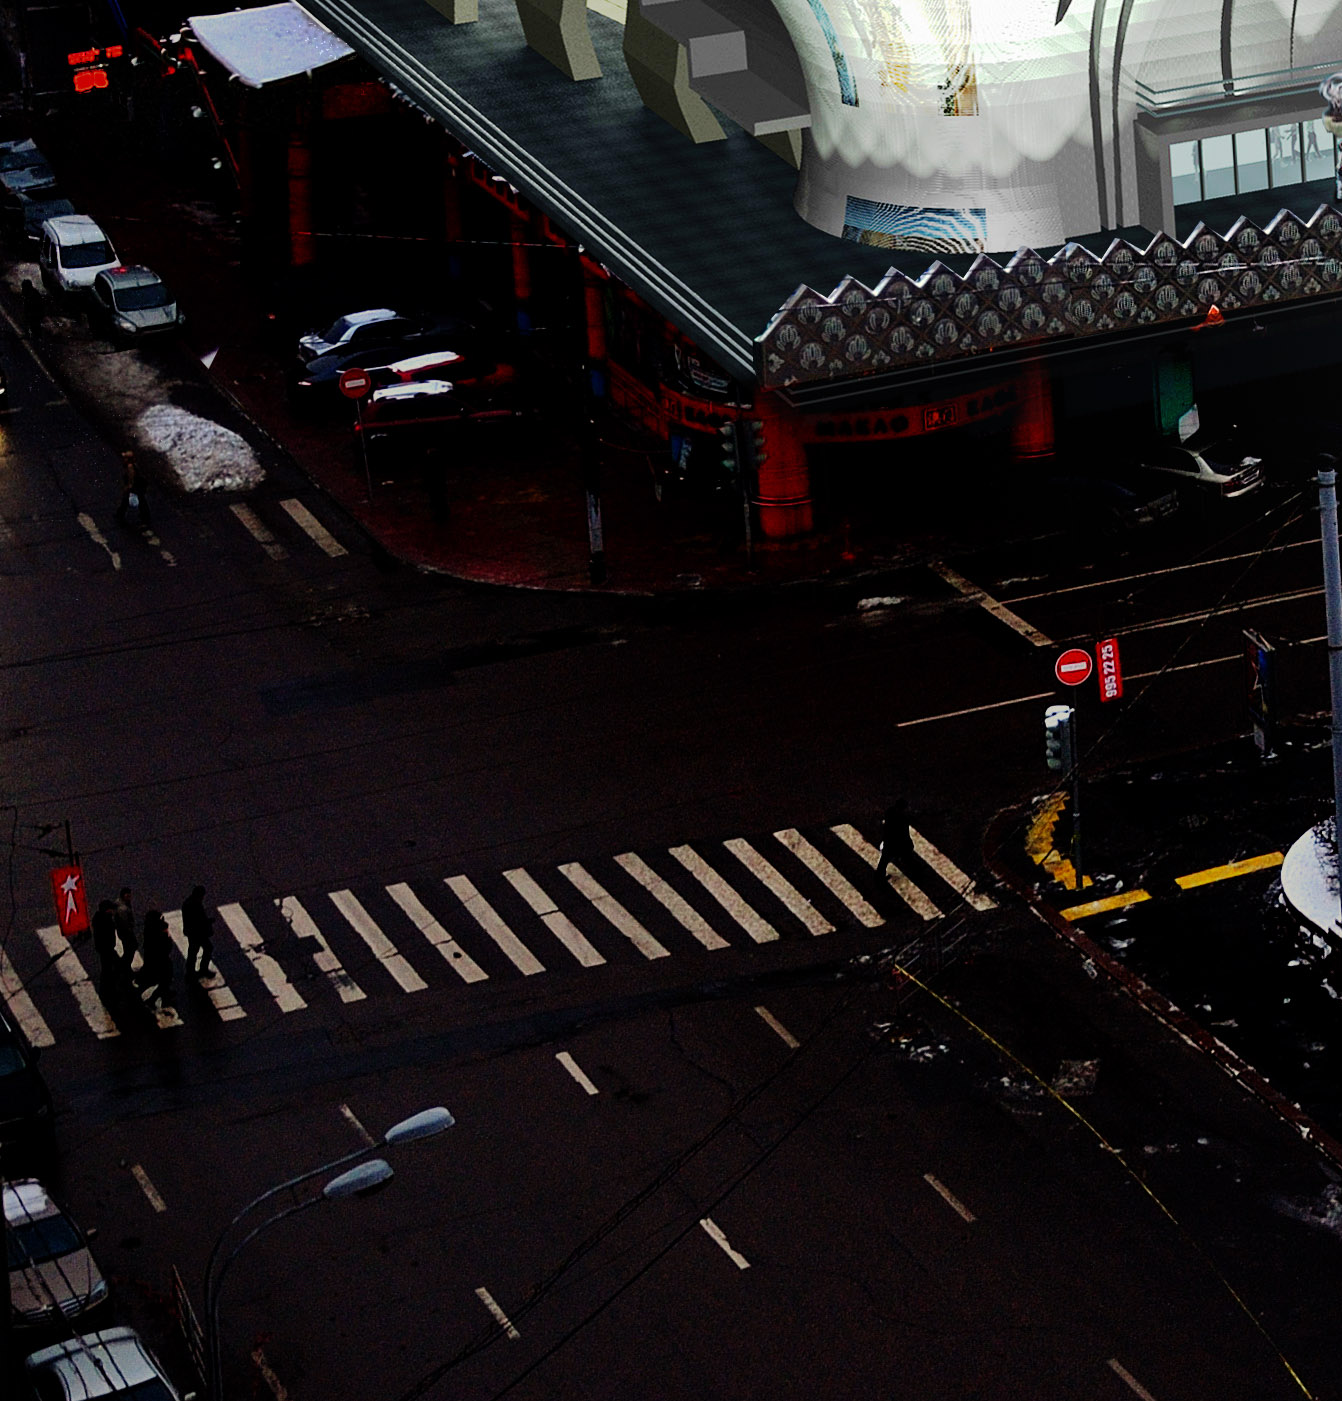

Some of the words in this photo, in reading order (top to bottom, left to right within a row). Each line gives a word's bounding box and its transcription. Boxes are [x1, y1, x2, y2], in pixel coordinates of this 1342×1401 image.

[1101, 644, 1113, 658] 25
[1103, 660, 1116, 673] 22
[1105, 675, 1117, 697] 995
